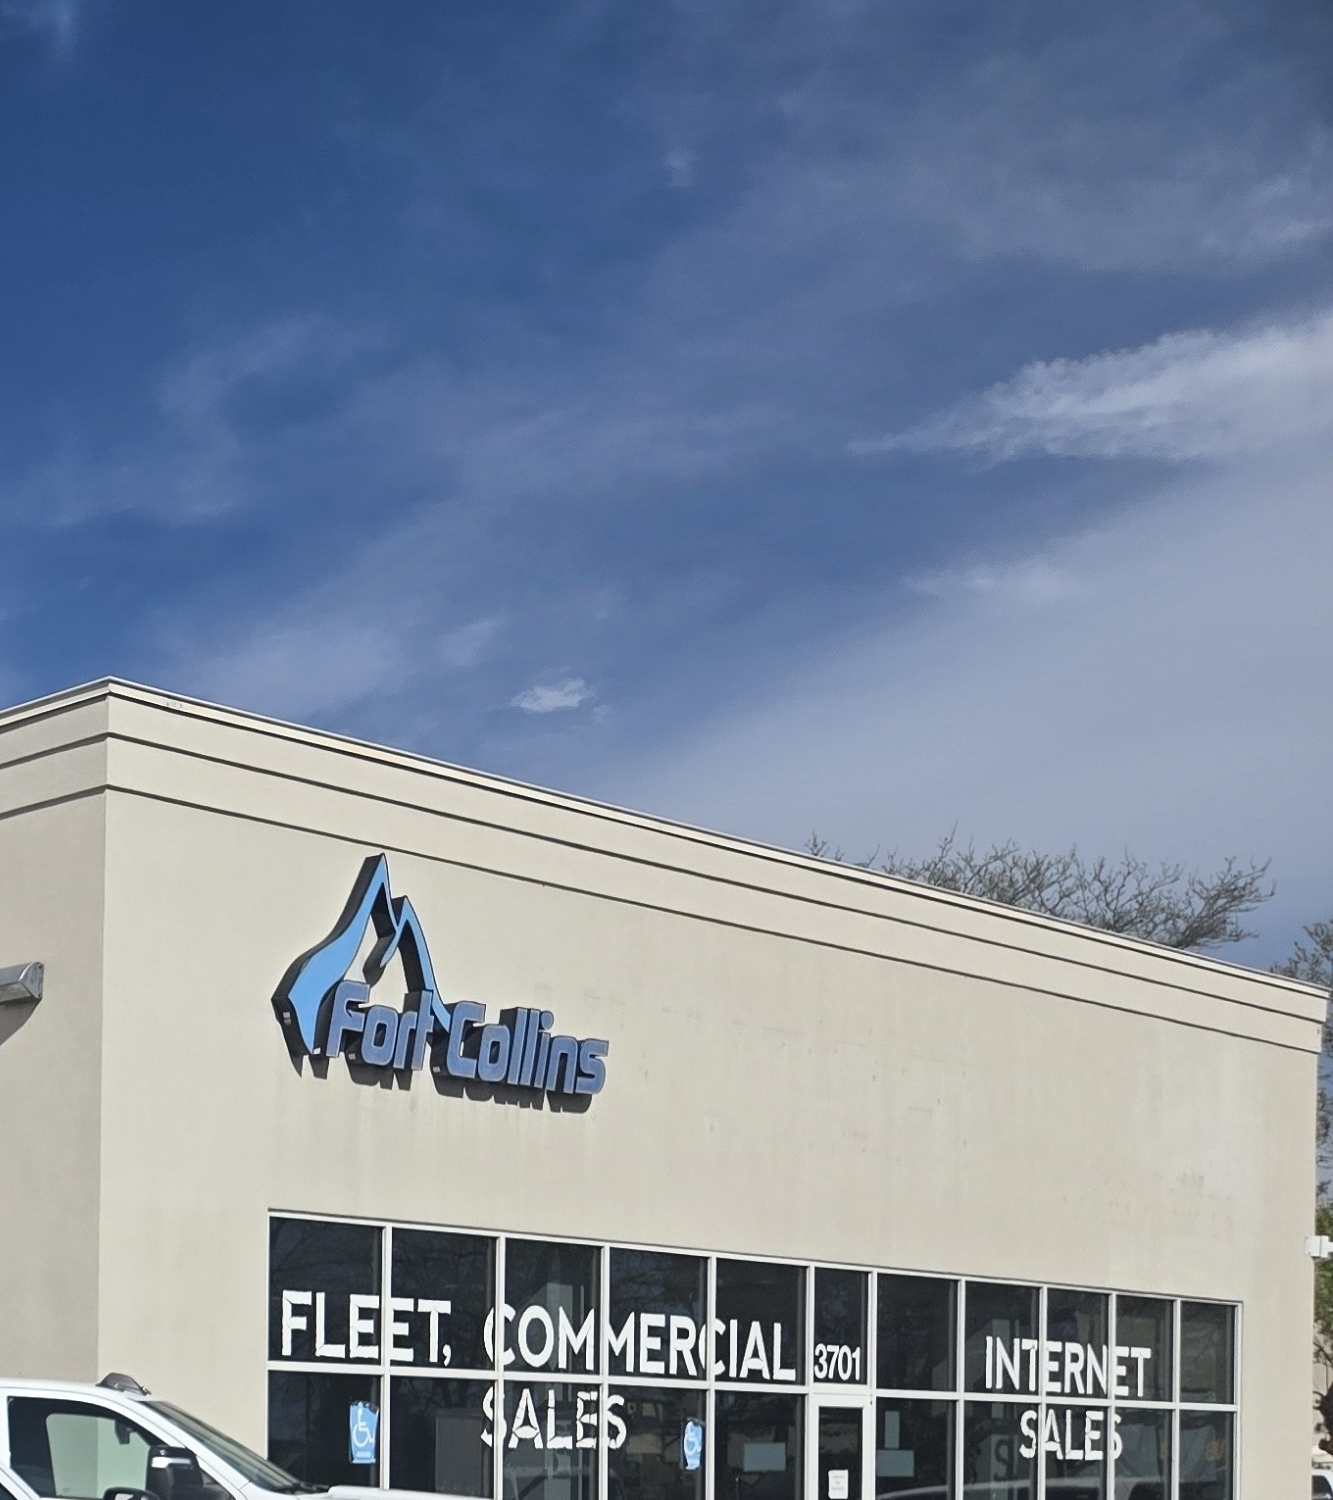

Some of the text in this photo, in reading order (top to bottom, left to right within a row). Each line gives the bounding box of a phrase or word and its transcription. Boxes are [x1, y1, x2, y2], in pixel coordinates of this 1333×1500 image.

[325, 979, 609, 1095] Fort Collins
[282, 1289, 796, 1381] FLEET, COMMERCIAL
[814, 1343, 861, 1381] 3701
[985, 1336, 1152, 1397] INTERNET
[481, 1385, 627, 1450] SALES
